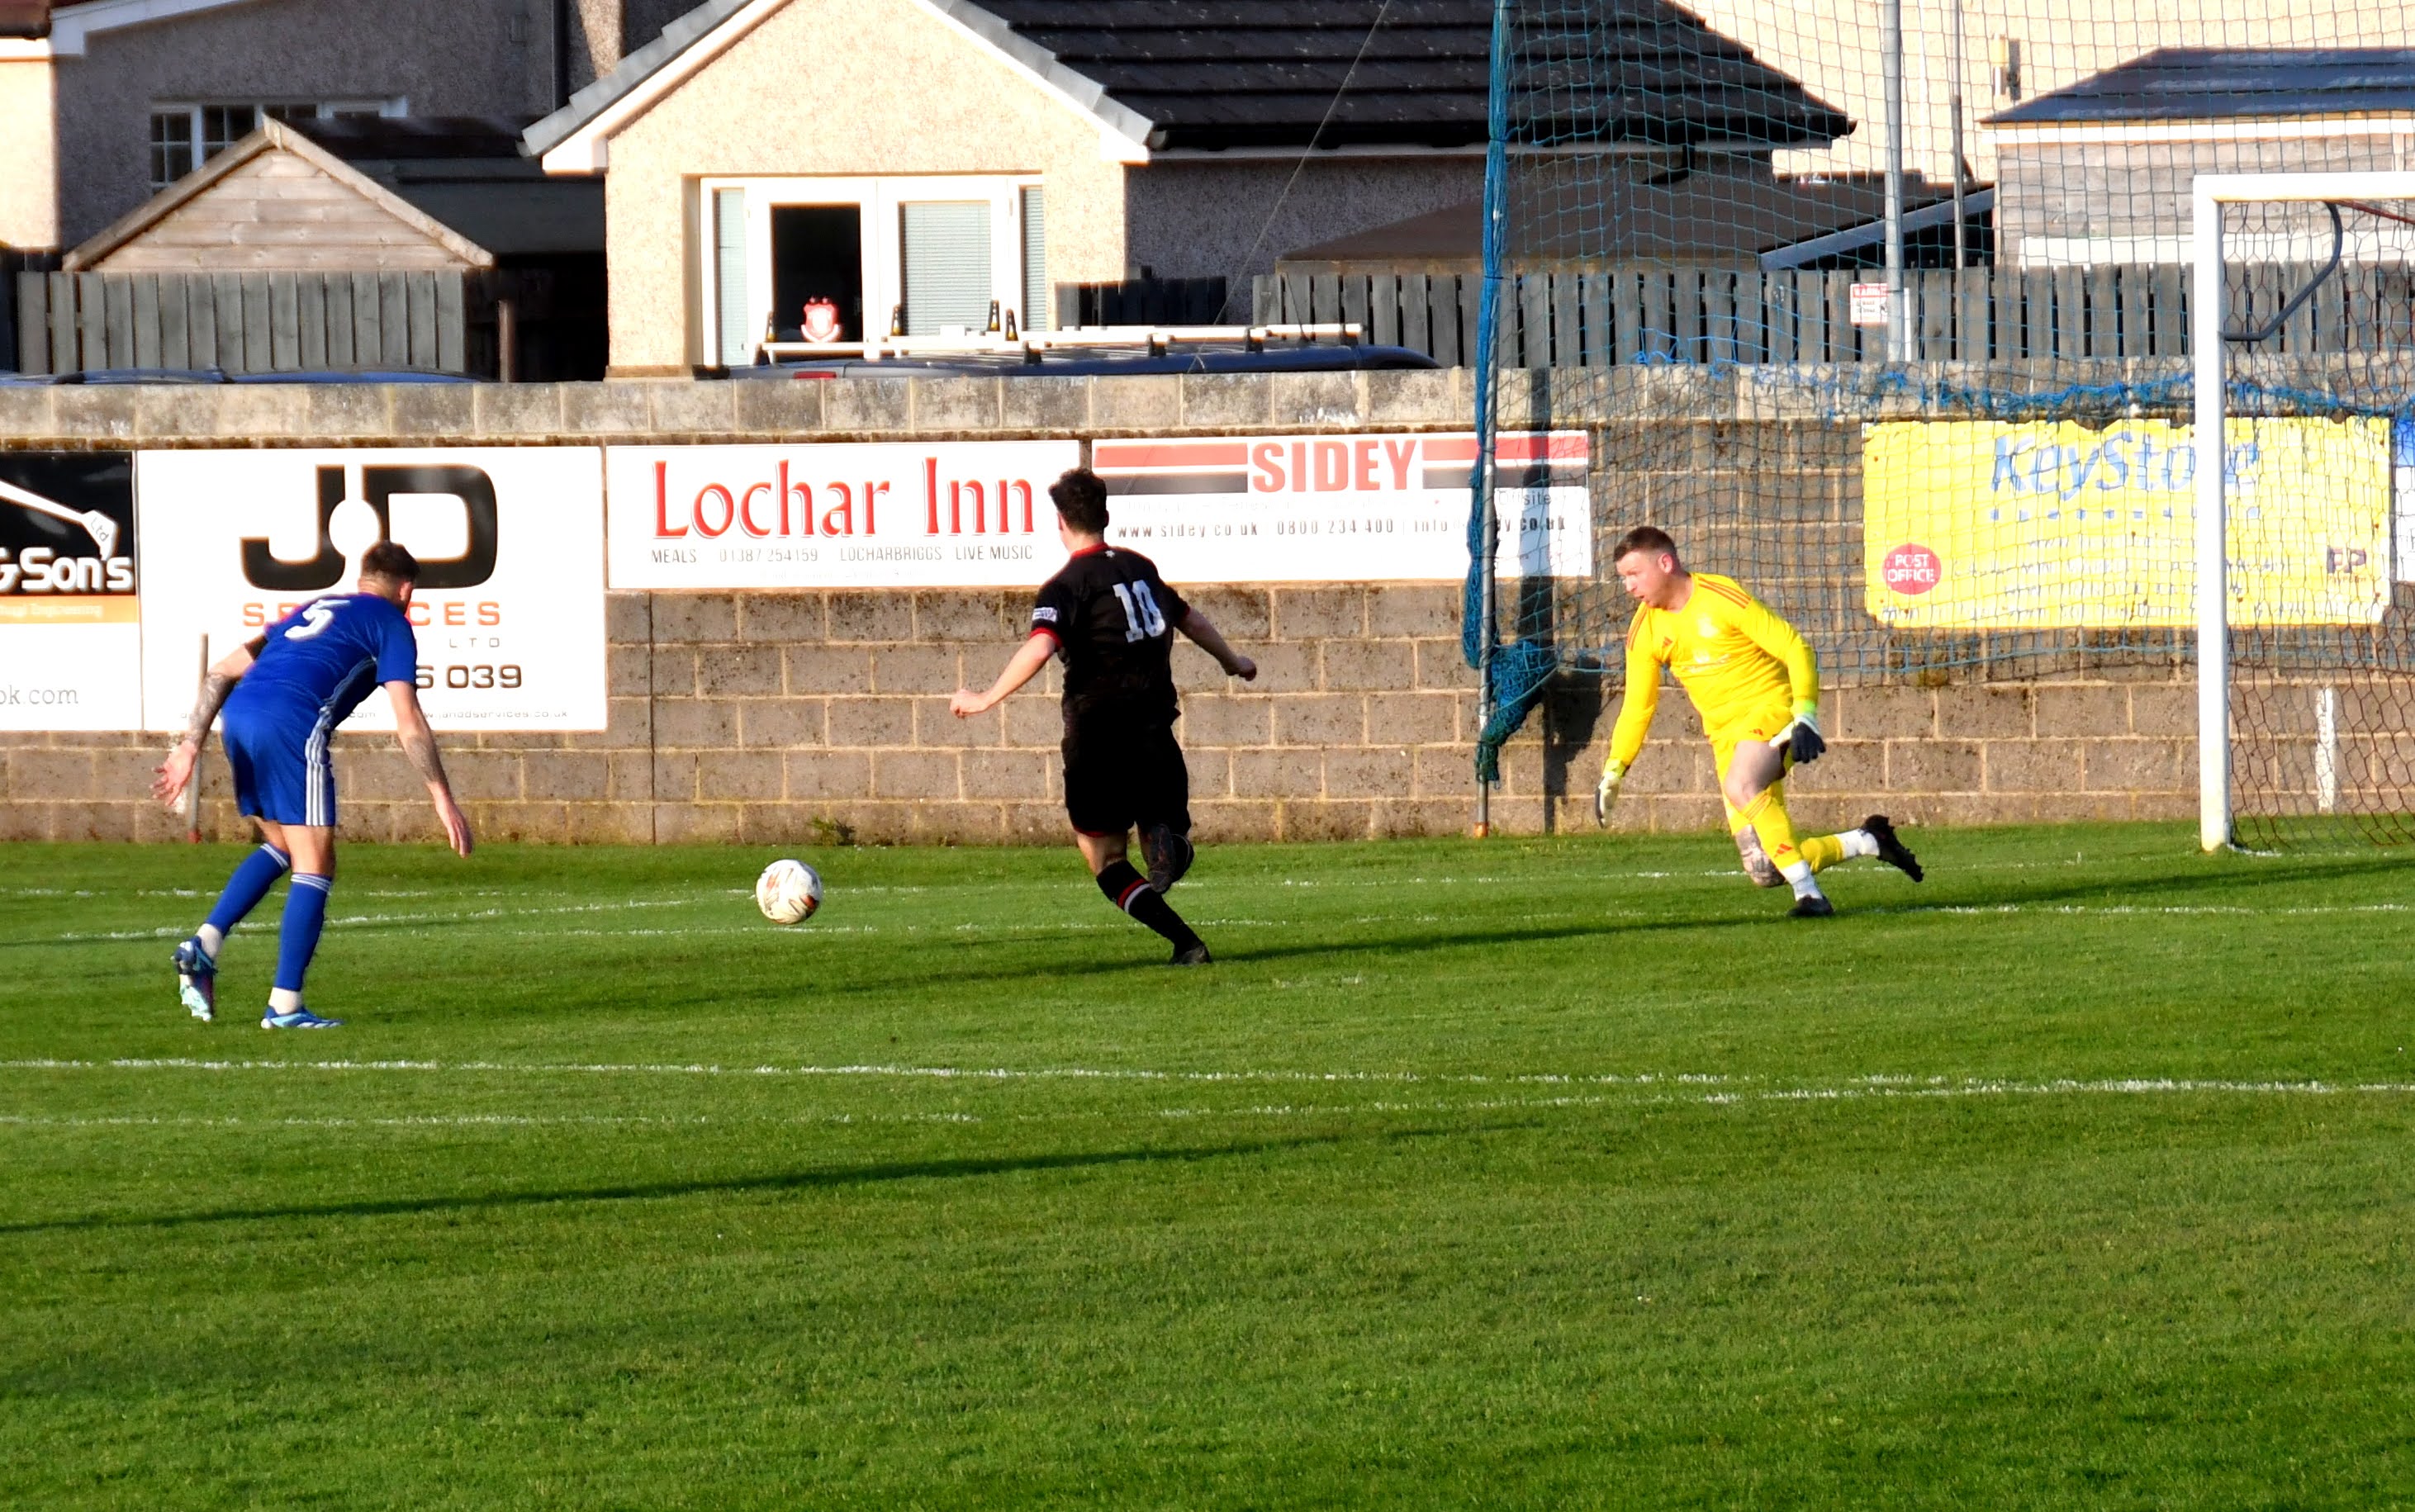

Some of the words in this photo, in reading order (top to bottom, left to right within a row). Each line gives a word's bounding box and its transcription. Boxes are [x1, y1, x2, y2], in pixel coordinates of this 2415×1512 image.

[1252, 439, 1417, 493] SIDEY
[652, 458, 890, 539] Lochar
[923, 456, 1034, 537] Inn
[91, 517, 109, 542] Ltd
[1278, 520, 1318, 535] 0800
[1328, 519, 1359, 534] 234
[1365, 518, 1393, 533] 400
[651, 548, 697, 563] MEALS
[719, 547, 762, 562] 01387
[766, 547, 818, 562] 254159
[840, 546, 942, 562] LOCHARBRIGGS
[956, 546, 985, 562] LIVE
[990, 545, 1033, 561] MUSIC
[1895, 554, 1929, 568] POST
[1887, 568, 1934, 582] OFFICE
[284, 600, 350, 641] 5
[1112, 579, 1166, 642] 10
[449, 637, 500, 648] LTD
[446, 663, 522, 689] 039
